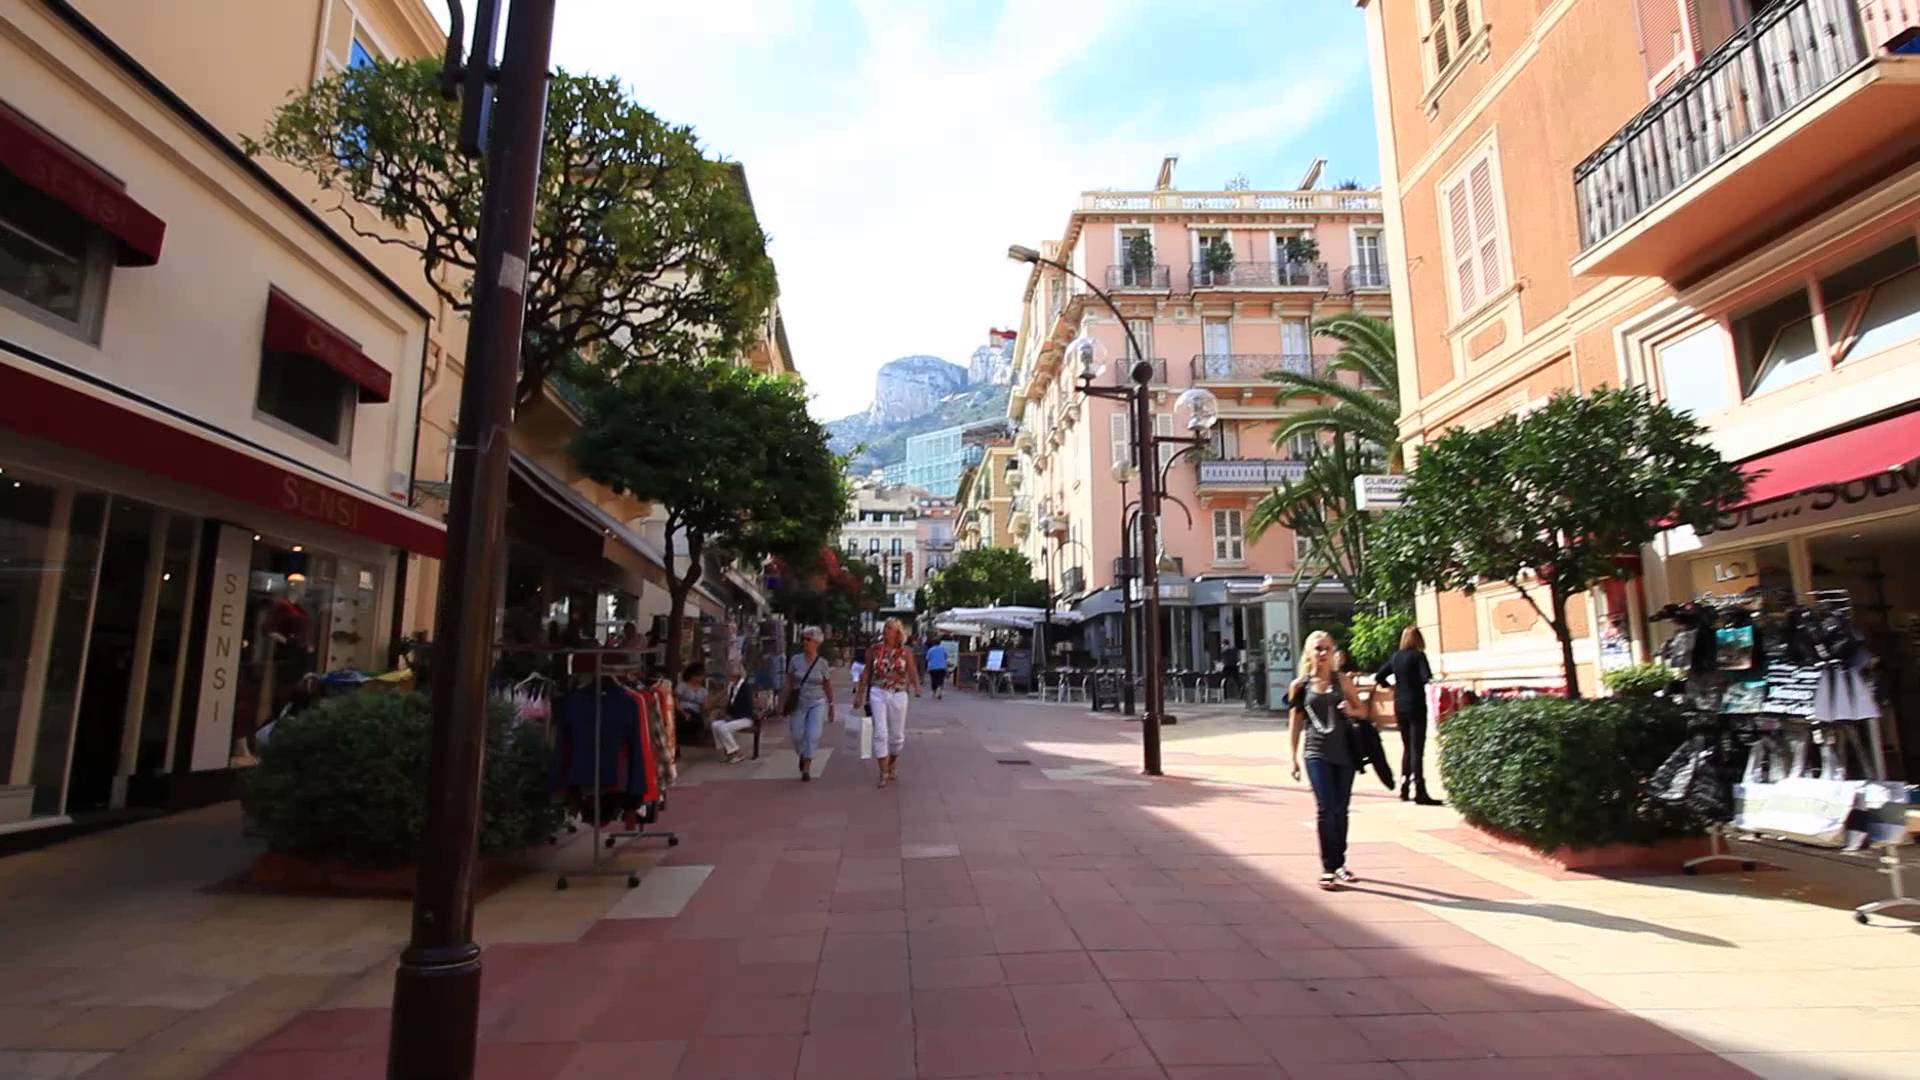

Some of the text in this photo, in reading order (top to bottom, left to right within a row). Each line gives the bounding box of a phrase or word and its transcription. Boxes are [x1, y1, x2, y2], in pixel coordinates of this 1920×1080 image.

[281, 475, 359, 529] SENSI
[211, 573, 238, 722] SENSI
[1271, 631, 1291, 662] 3G
